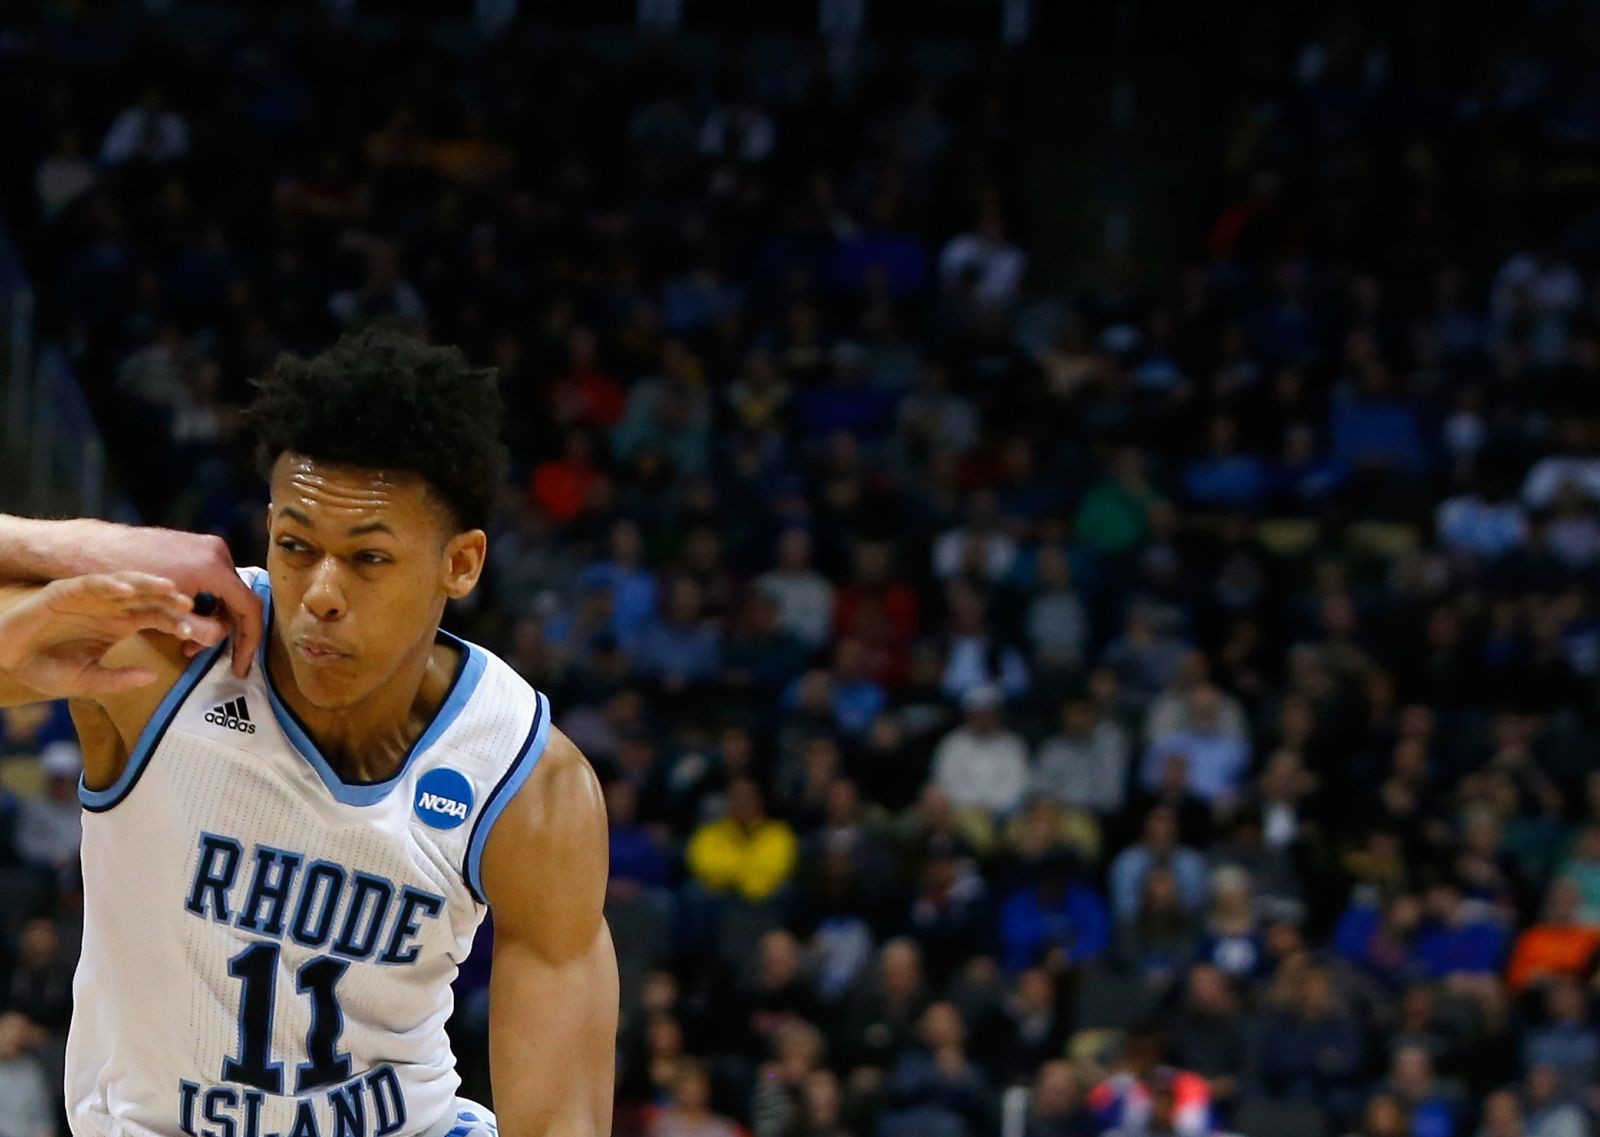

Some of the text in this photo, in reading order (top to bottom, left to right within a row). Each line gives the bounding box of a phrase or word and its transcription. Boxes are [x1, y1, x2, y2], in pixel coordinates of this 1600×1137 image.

[204, 712, 256, 734] adidas
[418, 792, 467, 819] NCAA
[184, 831, 447, 966] RHODE
[220, 942, 352, 1096] 11
